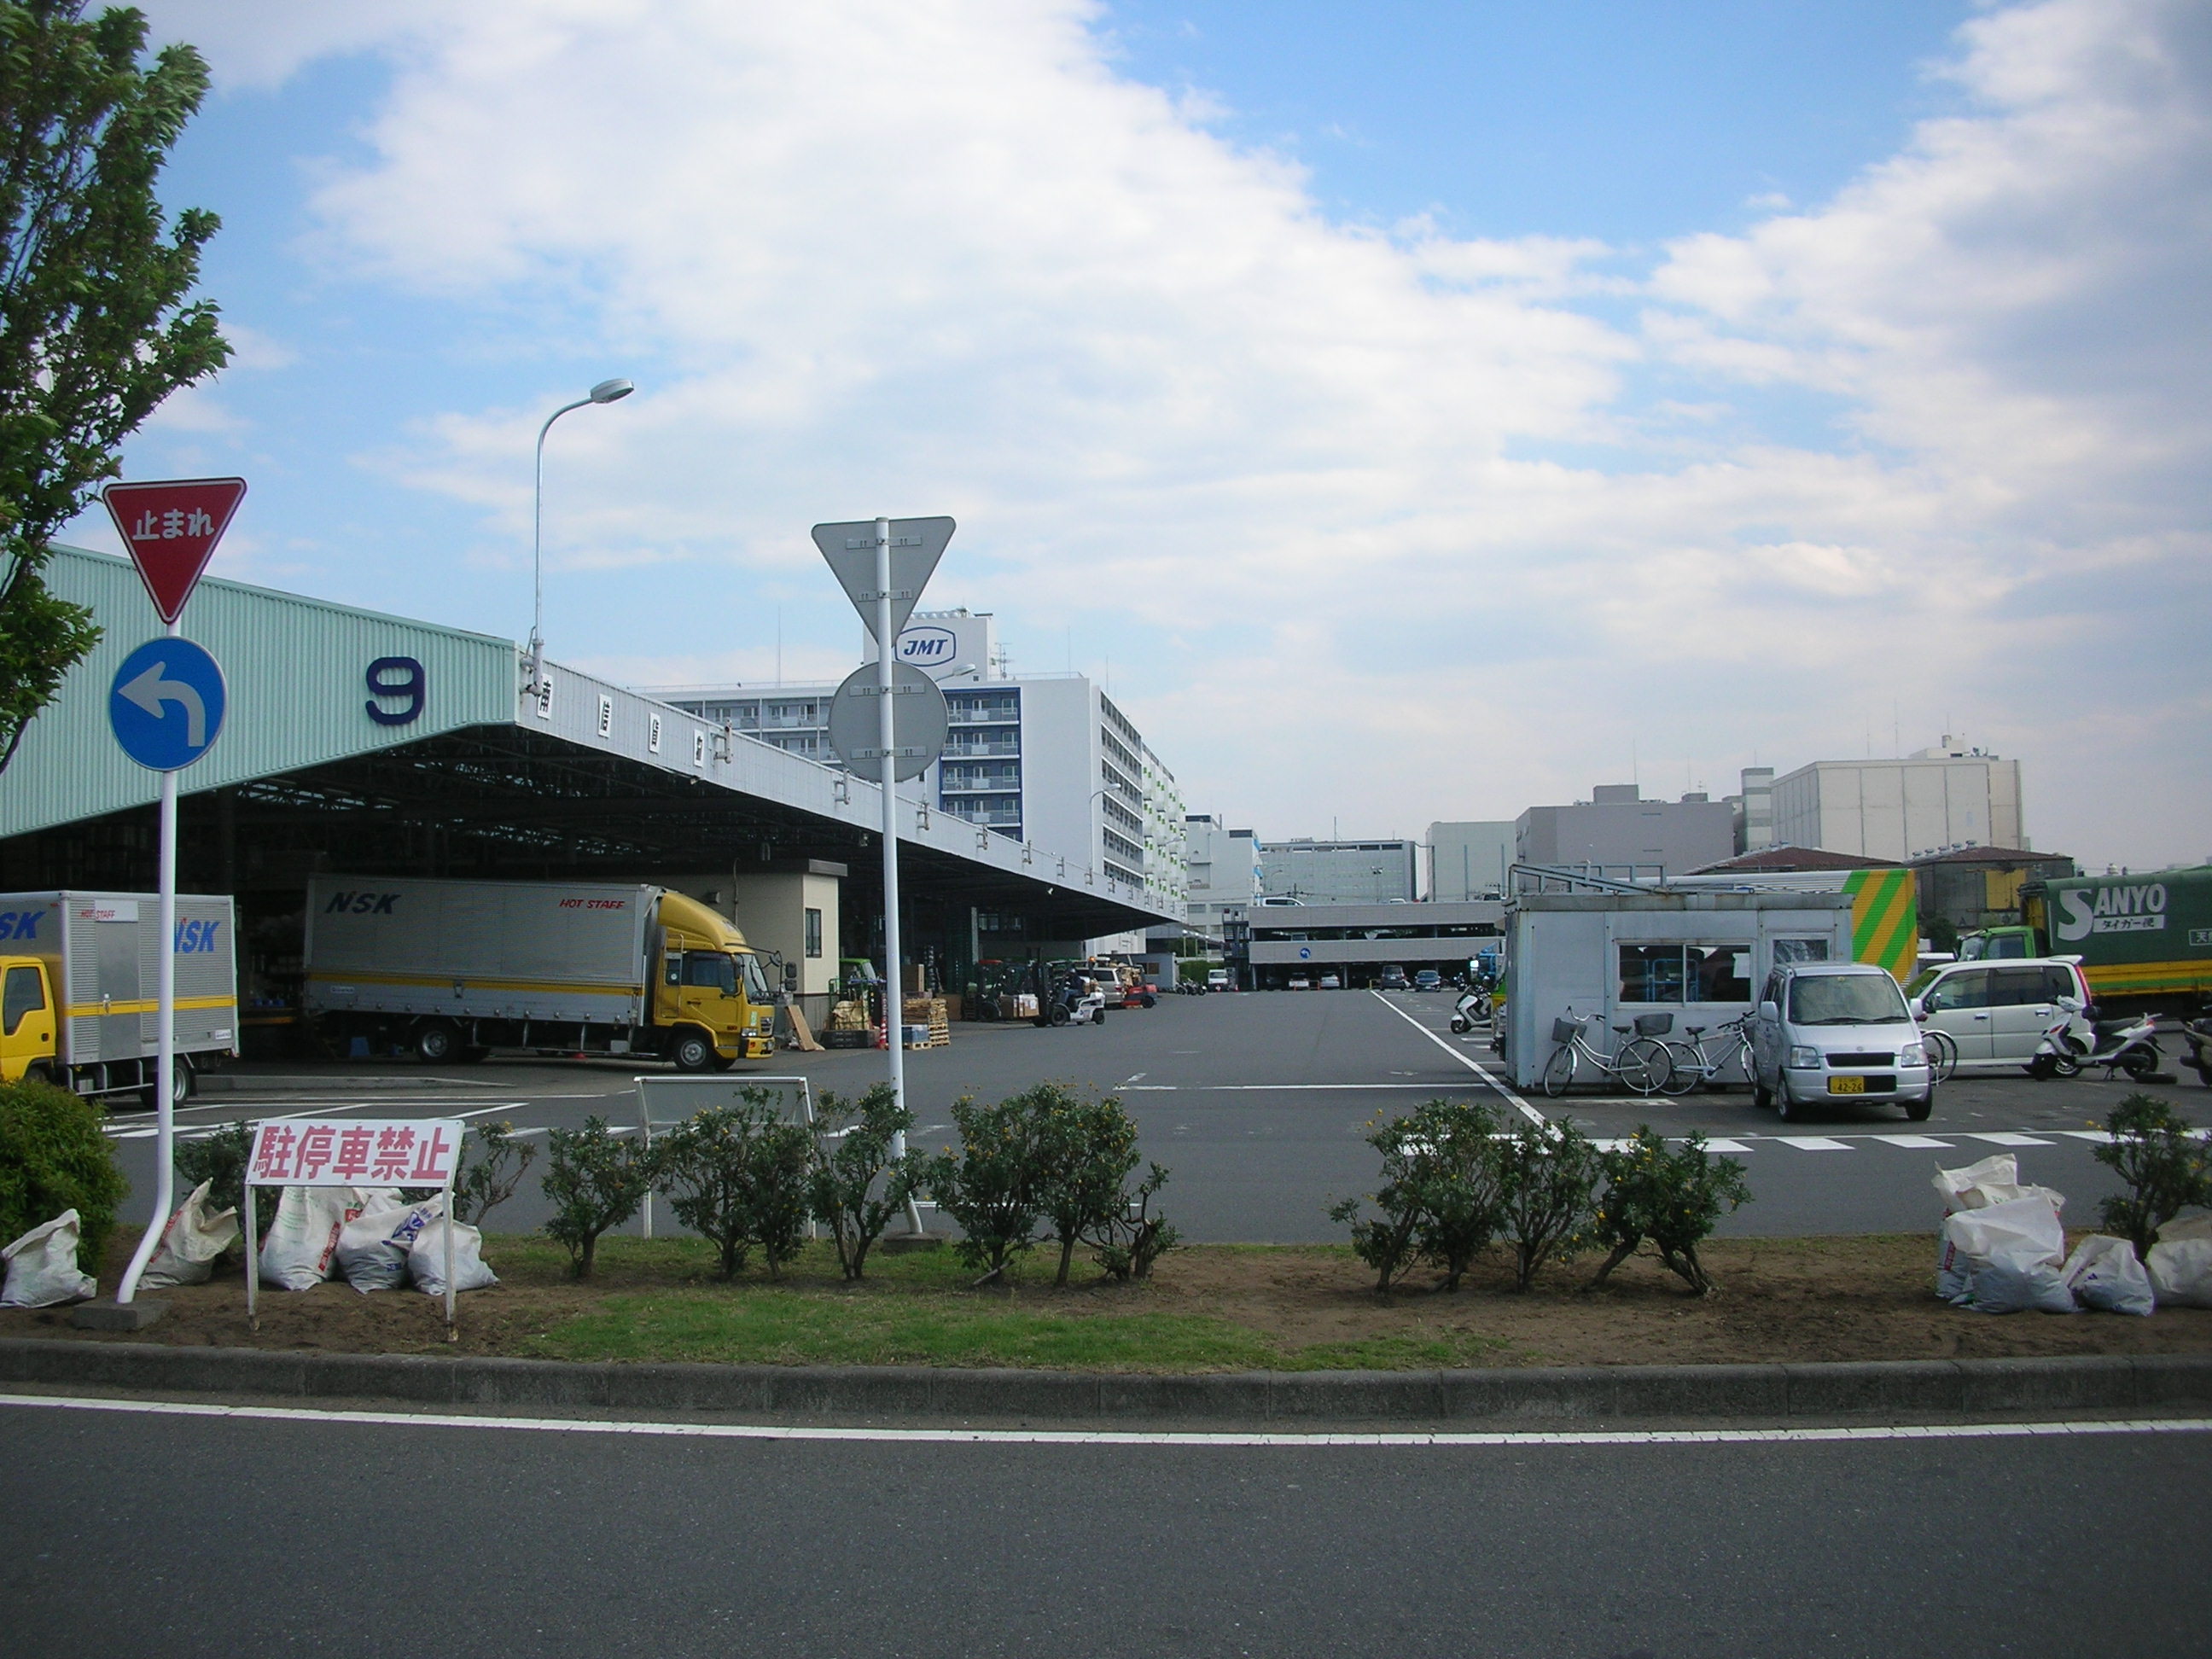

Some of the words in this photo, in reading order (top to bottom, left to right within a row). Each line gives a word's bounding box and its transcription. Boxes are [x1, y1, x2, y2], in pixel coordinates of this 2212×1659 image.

[132, 507, 215, 540] 止まれ
[904, 638, 948, 655] JMT
[365, 656, 425, 725] 9
[325, 891, 401, 914] NSK
[559, 899, 584, 908] HOT
[586, 899, 626, 909] STAFF
[2058, 883, 2166, 940] SANYO
[2103, 917, 2155, 929] タイガー便
[2196, 931, 2212, 943] 天
[1837, 1083, 1862, 1091] 42-26
[253, 1125, 450, 1180] 駐停車禁止
